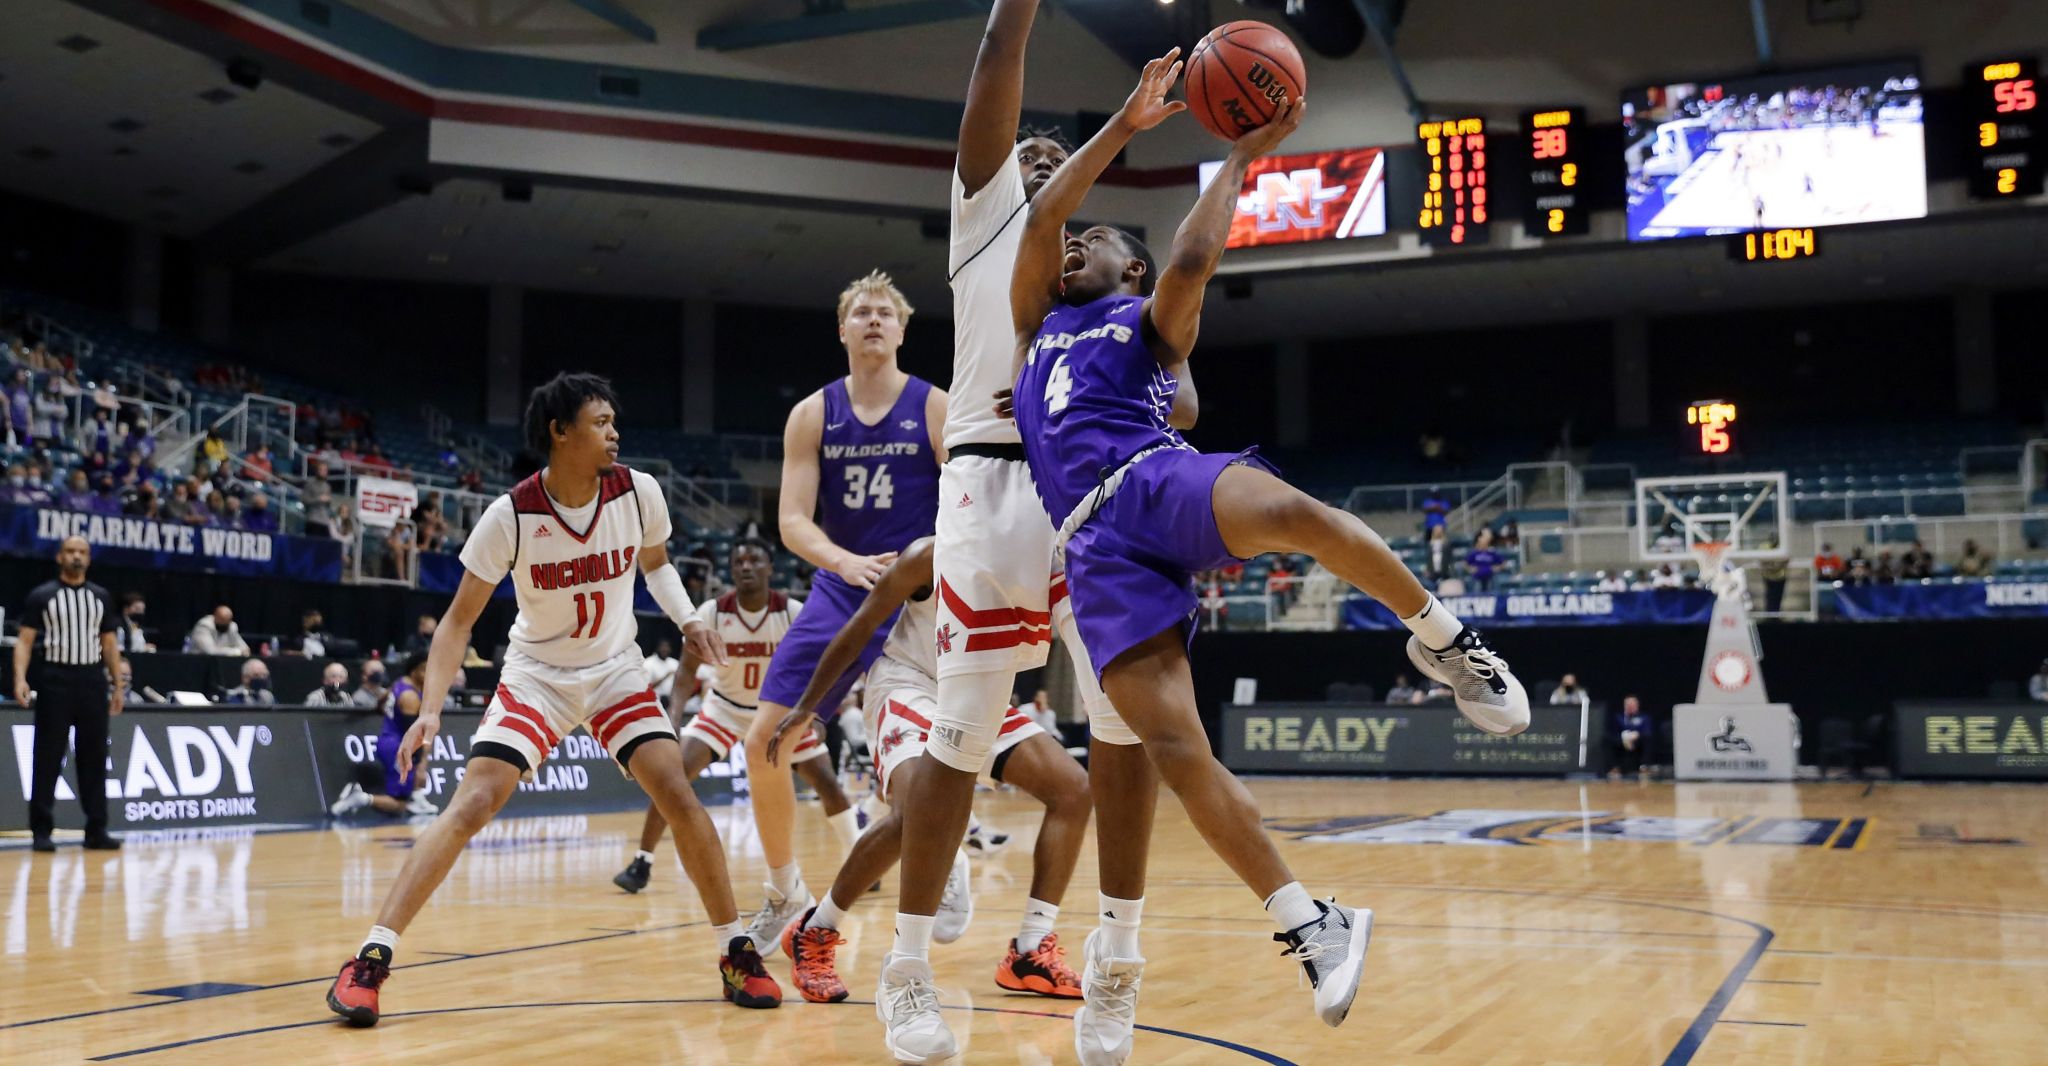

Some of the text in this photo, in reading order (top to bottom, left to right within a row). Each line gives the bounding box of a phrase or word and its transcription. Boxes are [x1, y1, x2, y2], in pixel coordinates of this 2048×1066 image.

[1247, 61, 1289, 106] Wil
[1995, 80, 2036, 113] 55
[1532, 128, 1567, 159] 38
[1980, 122, 1998, 147] 3
[1561, 163, 1577, 186] 2
[1997, 168, 2017, 193] 2
[1548, 209, 1564, 232] 2
[1745, 229, 1815, 261] 11:04
[1044, 353, 1074, 416] 4
[823, 442, 920, 460] WILDCATS
[843, 464, 894, 509] 34
[37, 508, 272, 561] INCARNATE WORD
[530, 545, 636, 591] NICHOLLS
[569, 591, 605, 639] 11
[1441, 594, 1613, 617] NEW ORLEANS
[744, 662, 760, 690] 0
[344, 734, 465, 762] OFAL
[565, 735, 608, 759] DRI
[1245, 717, 1398, 751] READY
[1925, 716, 2048, 753] REA
[12, 724, 256, 801] RADY
[125, 797, 257, 821] SPORTS DRINK
